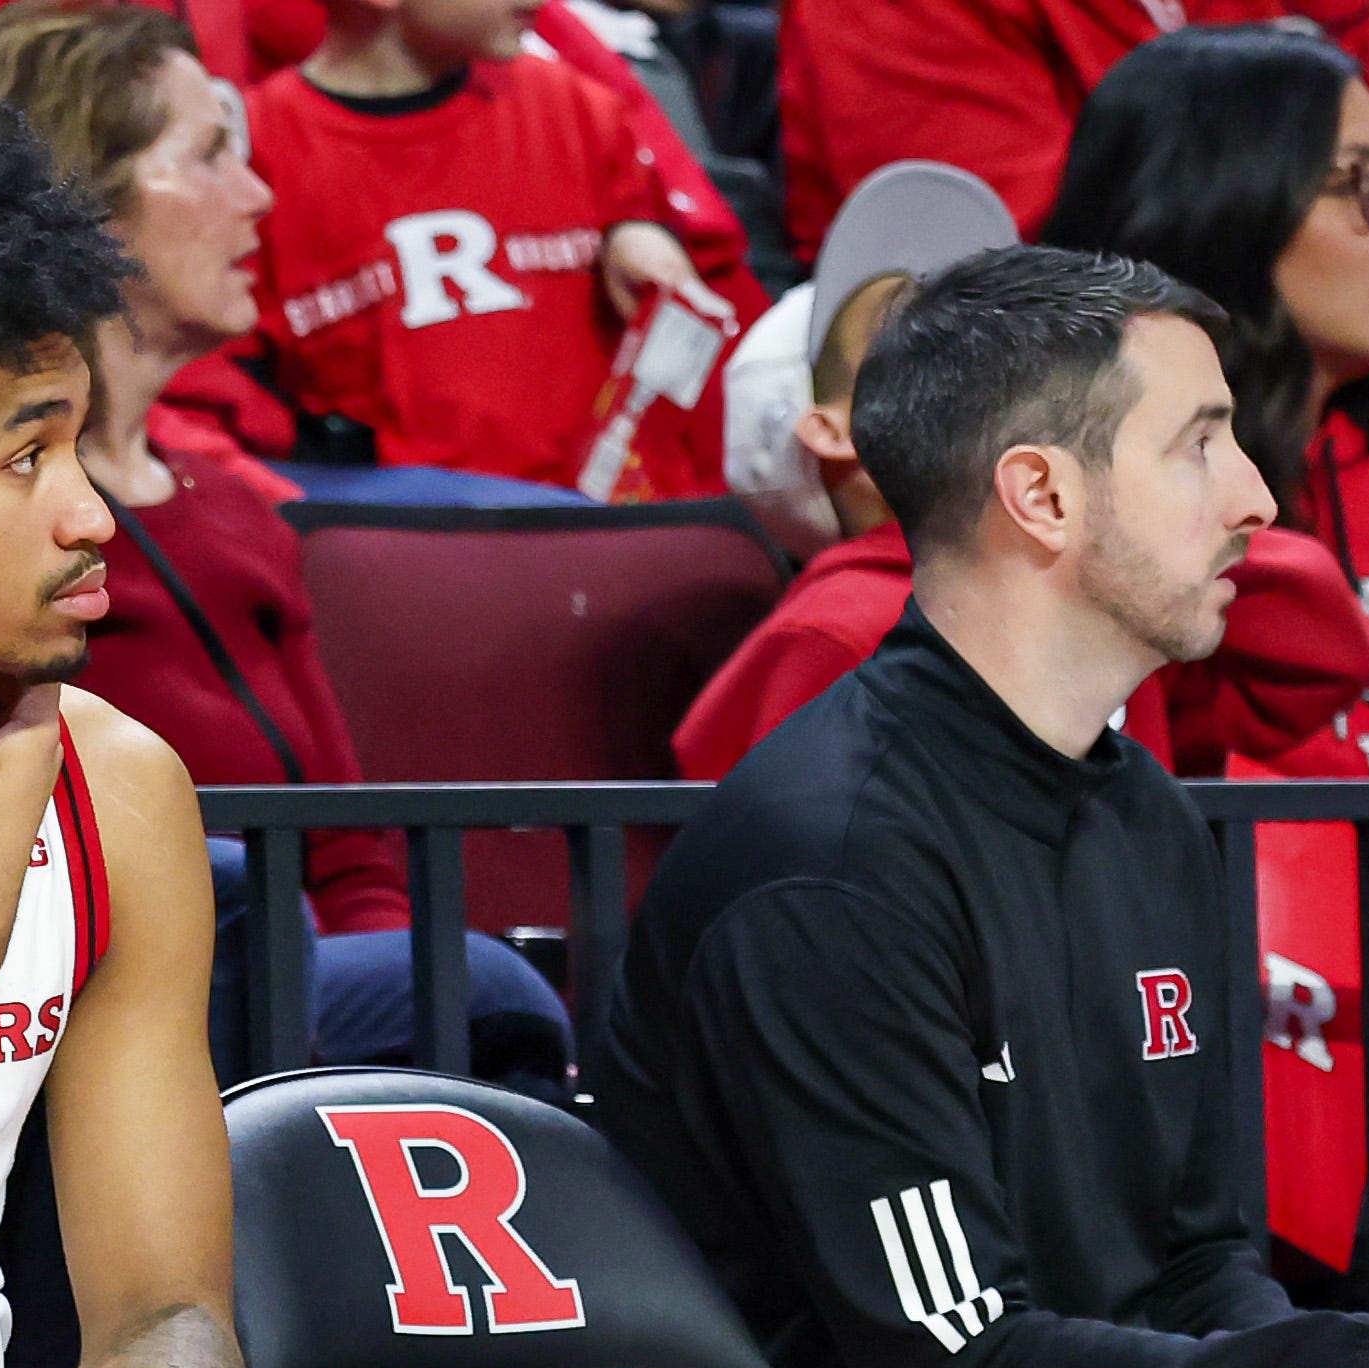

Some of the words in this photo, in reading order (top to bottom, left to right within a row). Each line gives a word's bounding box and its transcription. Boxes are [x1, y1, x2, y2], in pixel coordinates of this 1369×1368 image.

[385, 210, 524, 330] R
[1136, 968, 1197, 1060] R
[1264, 951, 1336, 1072] R
[315, 1104, 586, 1335] R
